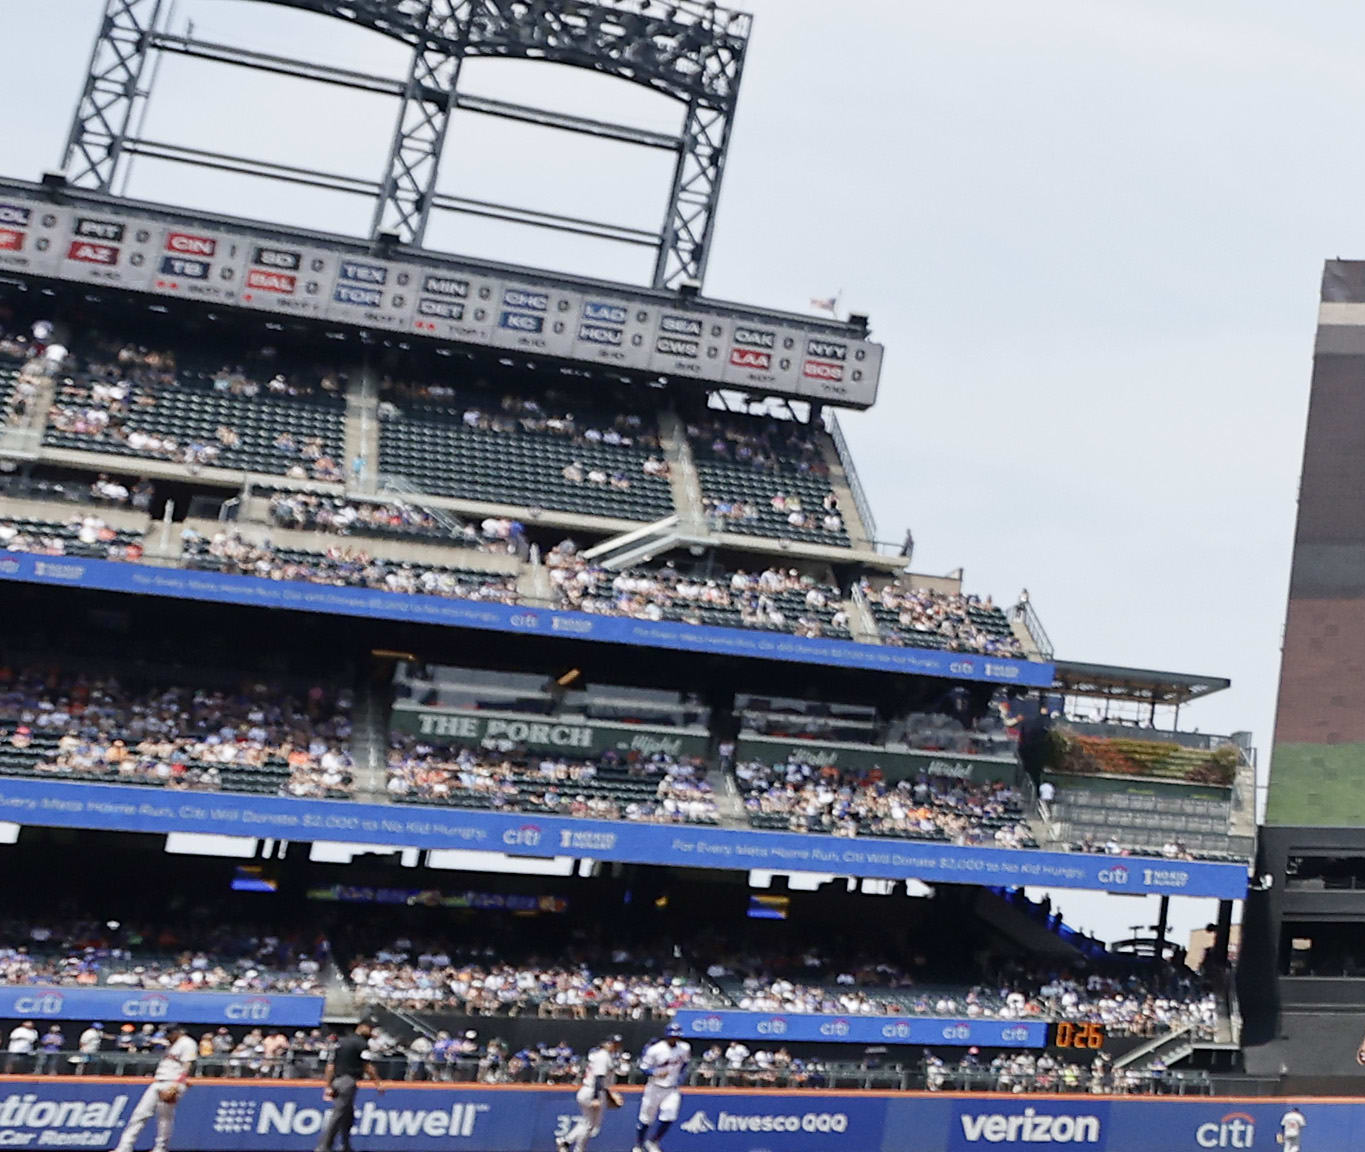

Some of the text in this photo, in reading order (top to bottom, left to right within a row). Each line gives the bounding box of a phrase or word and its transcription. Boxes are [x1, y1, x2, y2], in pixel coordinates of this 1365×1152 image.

[171, 235, 212, 253] CIN
[345, 264, 384, 283] TEX
[428, 279, 465, 296] MIN
[585, 303, 625, 322] LAD
[508, 315, 537, 330] KC
[662, 317, 700, 334] SEA
[735, 329, 774, 347] OAK
[732, 350, 769, 368] LAA
[809, 342, 846, 359] NYY
[419, 714, 594, 747] THE PORCH
[503, 827, 541, 846] citi
[1098, 866, 1127, 883] citi
[15, 996, 63, 1014] citi
[123, 998, 169, 1017] citi
[225, 1001, 271, 1020] citi
[1056, 1021, 1104, 1048] 0:26
[0, 1095, 126, 1128] tional.
[257, 1102, 476, 1137] Nohwell
[717, 1111, 848, 1133] Invesco QQQ
[961, 1106, 1100, 1142] verizon
[0, 1129, 111, 1146] Car Rental
[1197, 1118, 1255, 1148] citi
